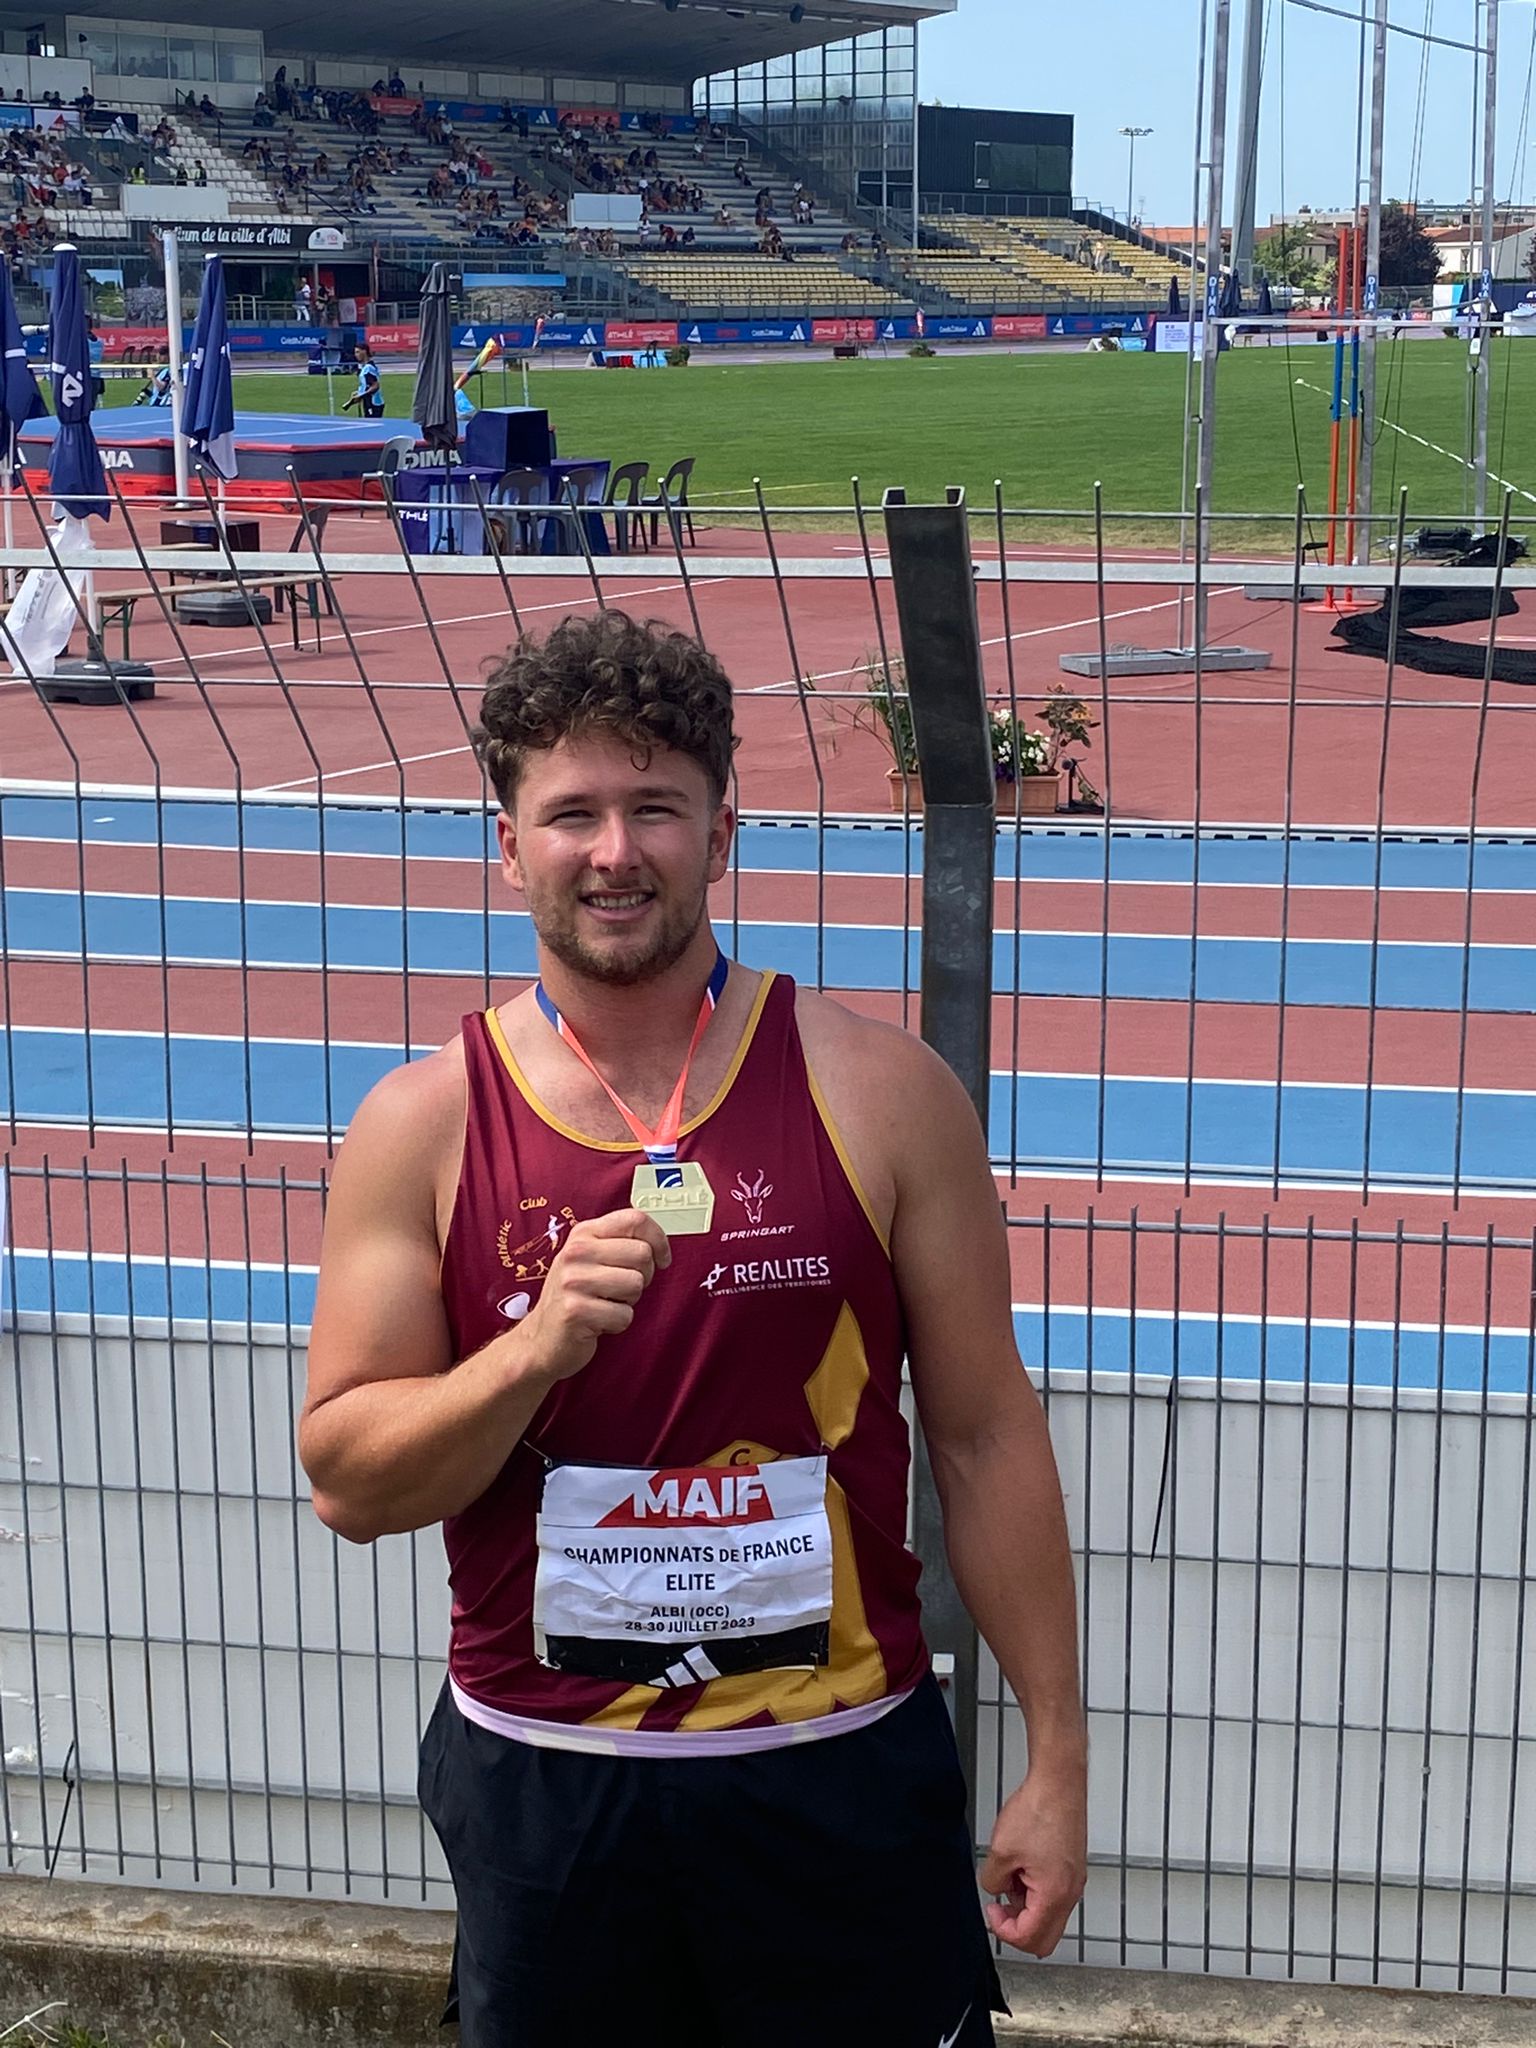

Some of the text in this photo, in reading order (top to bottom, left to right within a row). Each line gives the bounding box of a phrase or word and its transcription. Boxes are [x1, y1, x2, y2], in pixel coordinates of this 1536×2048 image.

[201, 227, 216, 242] de
[217, 227, 230, 242] la
[231, 227, 255, 243] ville
[1208, 276, 1217, 316] DIMA
[1367, 276, 1375, 309] DIMA
[403, 449, 462, 470] DIMA
[398, 509, 428, 521] THLÉ
[519, 1196, 548, 1211] Club
[720, 1225, 795, 1242] SPRINGART
[733, 1256, 830, 1284] REALITES
[633, 1475, 763, 1518] MAIF
[563, 1534, 814, 1565] CHAMPIONNATS DE FRANCE
[666, 1573, 716, 1591] ELITE
[650, 1604, 730, 1619] ALBI (OCC)
[624, 1616, 755, 1633] 28-30 JUILLET 2023
